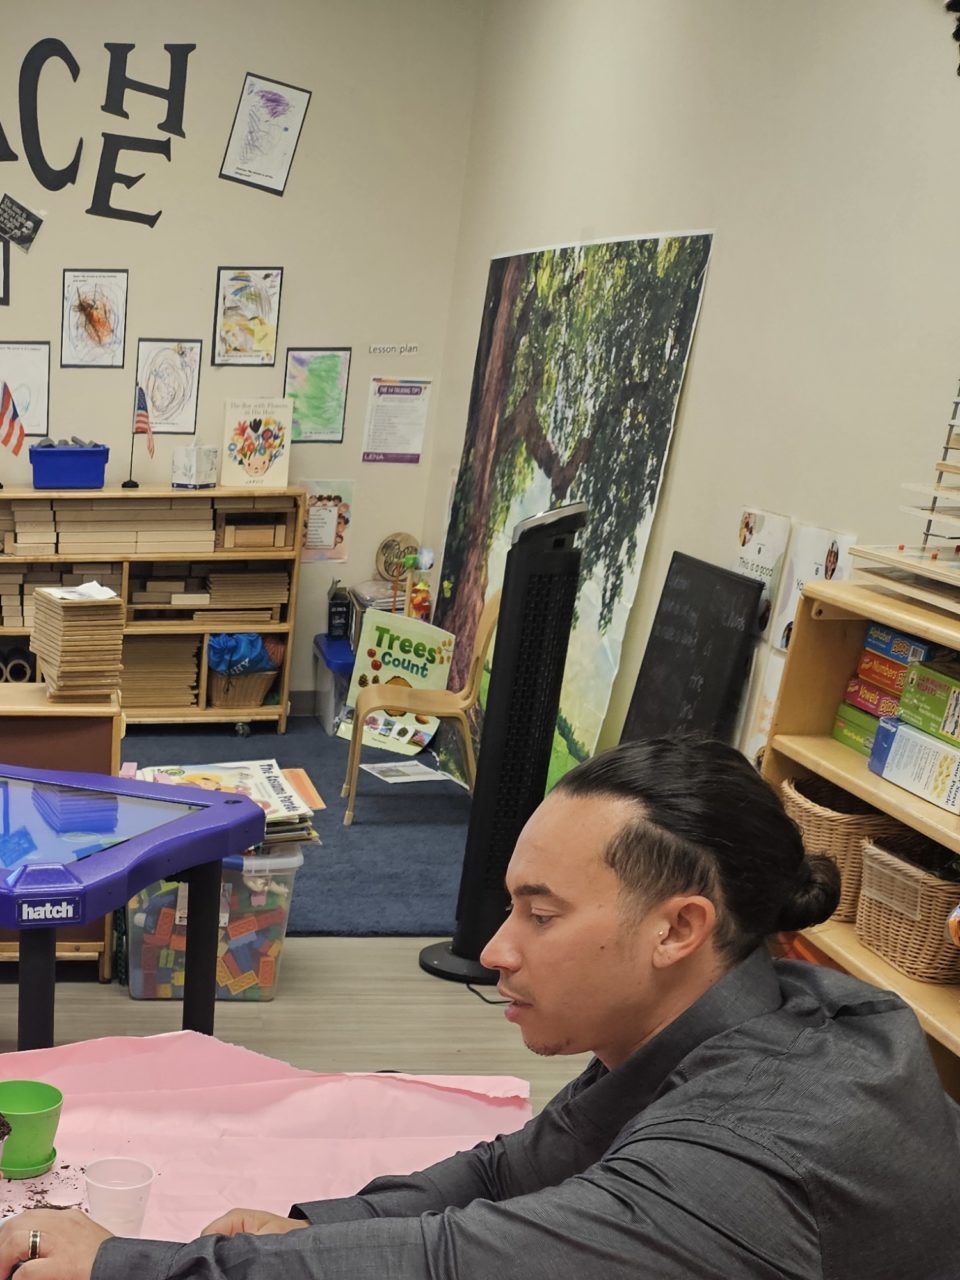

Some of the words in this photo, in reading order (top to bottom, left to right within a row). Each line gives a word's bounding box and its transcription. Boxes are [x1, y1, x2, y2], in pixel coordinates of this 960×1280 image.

[368, 344, 397, 354] Lesson
[399, 344, 419, 356] plan
[375, 625, 438, 665] Trees
[381, 651, 429, 679] Count
[859, 684, 880, 705] Vowels
[259, 763, 274, 775] The
[22, 901, 74, 920] hatch
